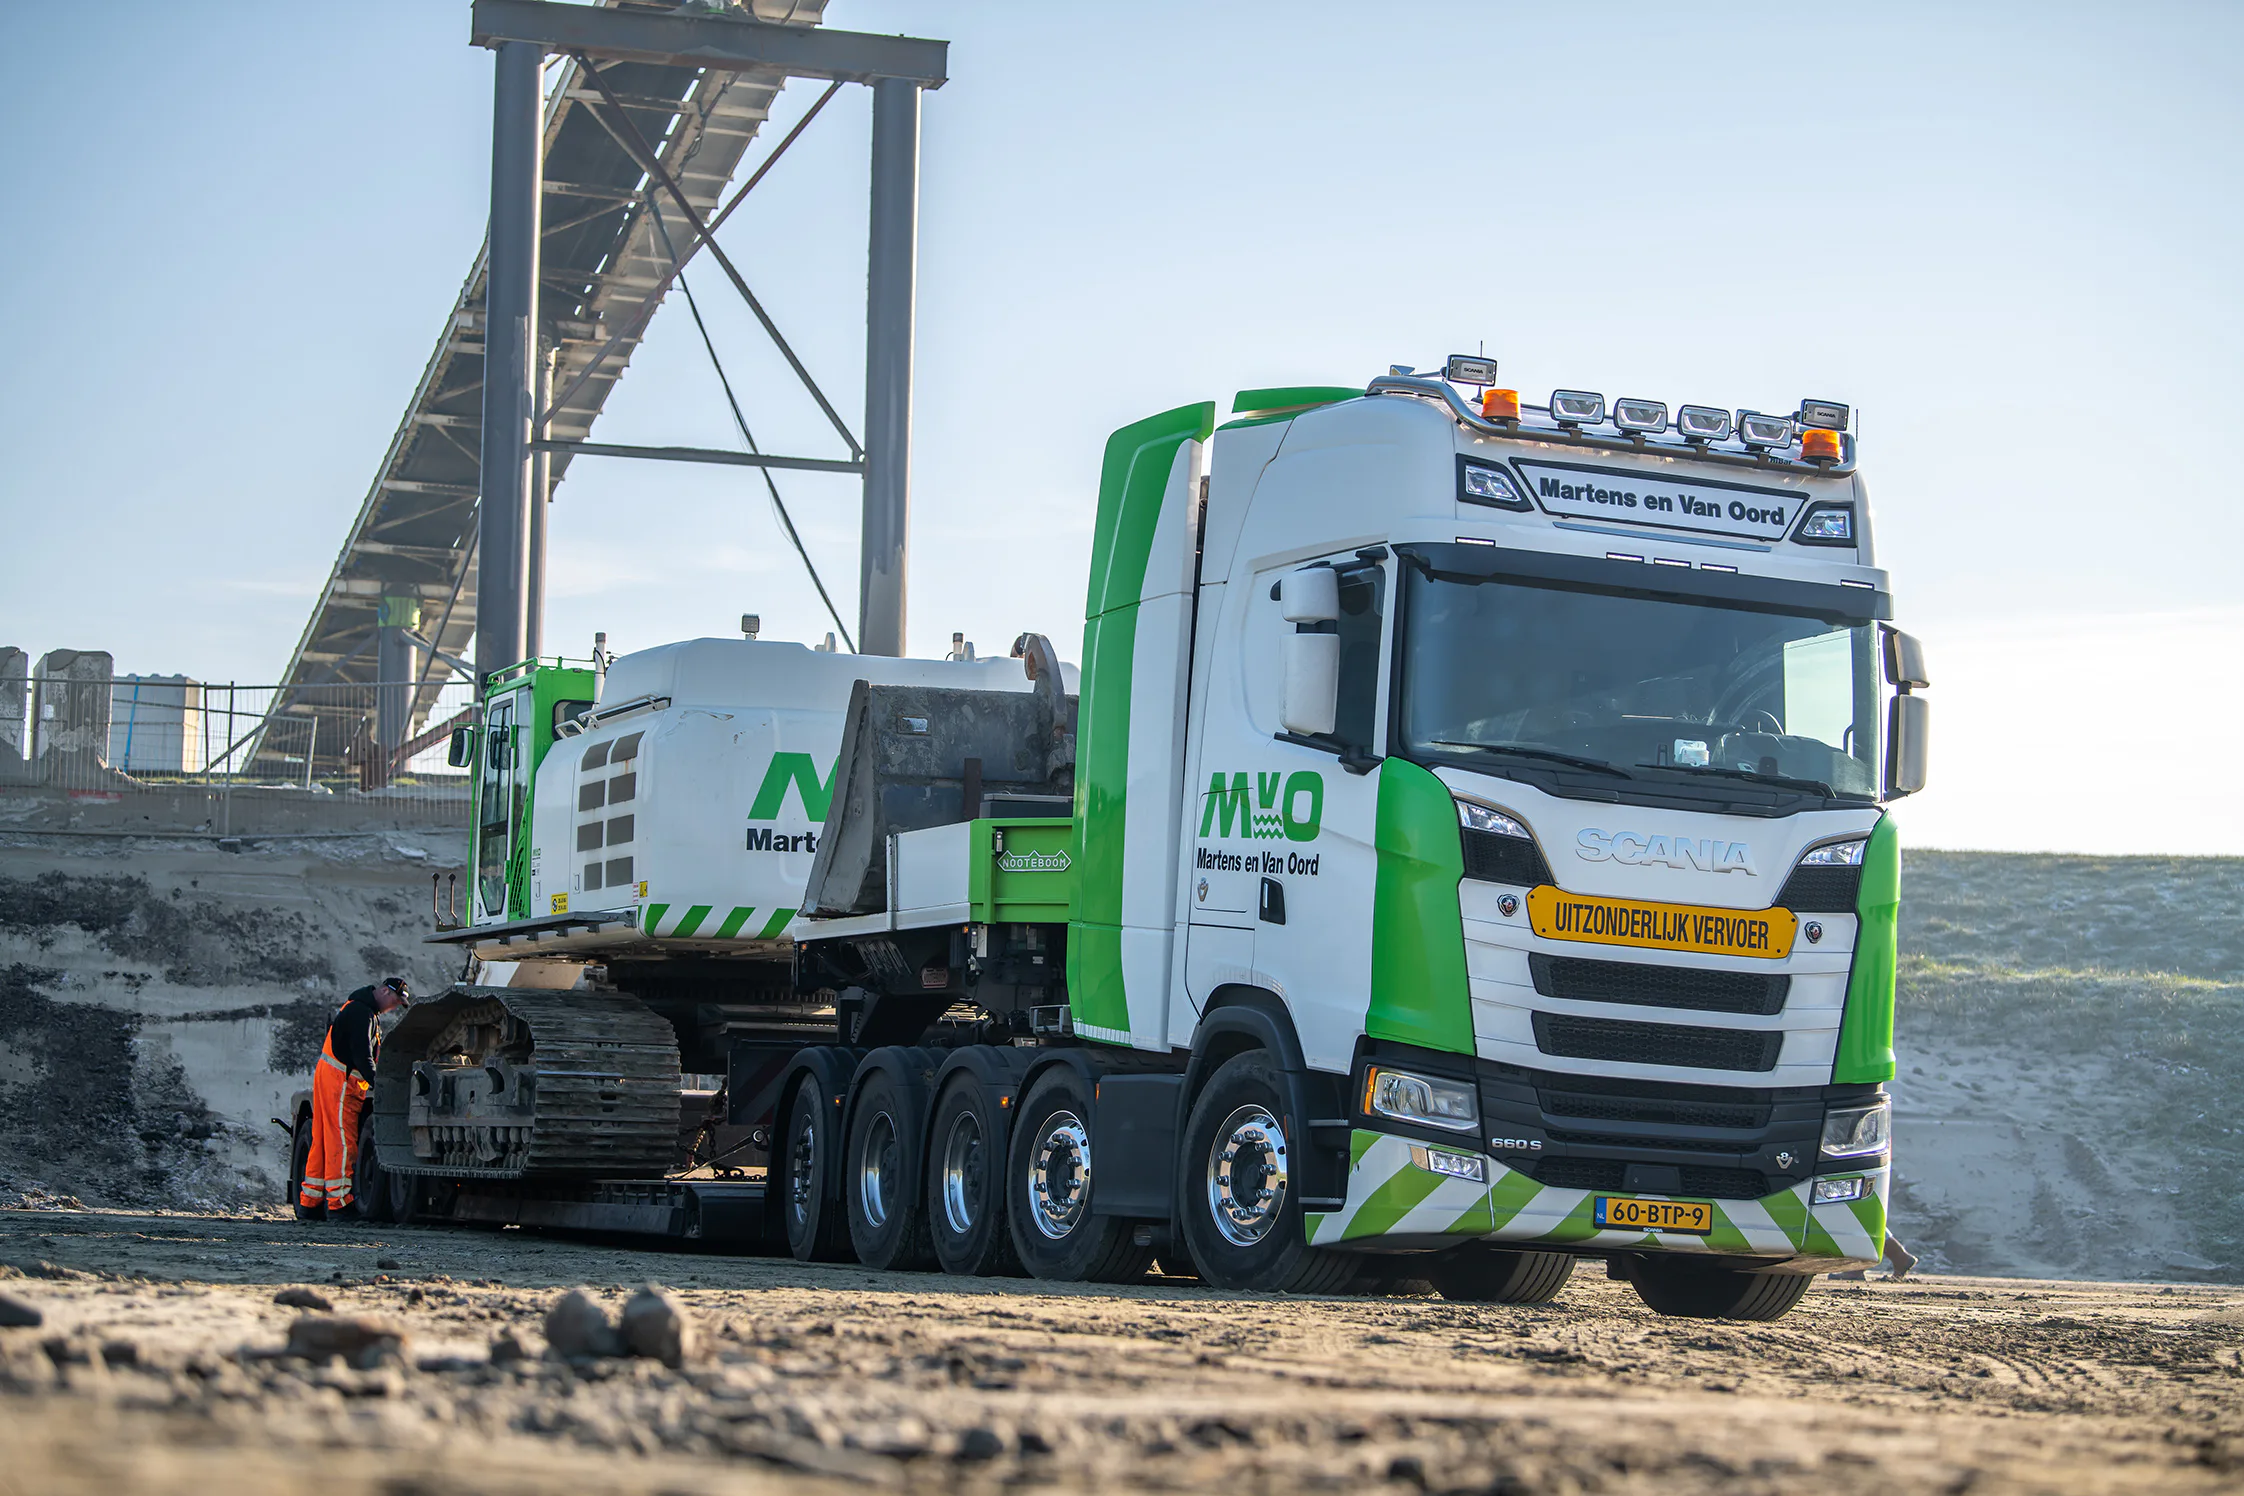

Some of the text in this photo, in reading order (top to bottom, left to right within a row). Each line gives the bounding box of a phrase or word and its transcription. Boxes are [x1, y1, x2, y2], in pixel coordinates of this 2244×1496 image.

[1539, 476, 1786, 527] Martens en Van Oord
[746, 828, 821, 853] Mart
[1575, 827, 1758, 877] SCANIA
[1002, 858, 1067, 868] NOOTEBOOM
[1196, 847, 1320, 876] Martens en Van Oord
[1555, 901, 1770, 950] UITZONDERLIJK VERVOER
[1491, 1137, 1543, 1150] 660 S
[1596, 1212, 1605, 1220] NL
[1612, 1202, 1705, 1226] 60-BTP-9
[1642, 1226, 1664, 1234] SCANIA
